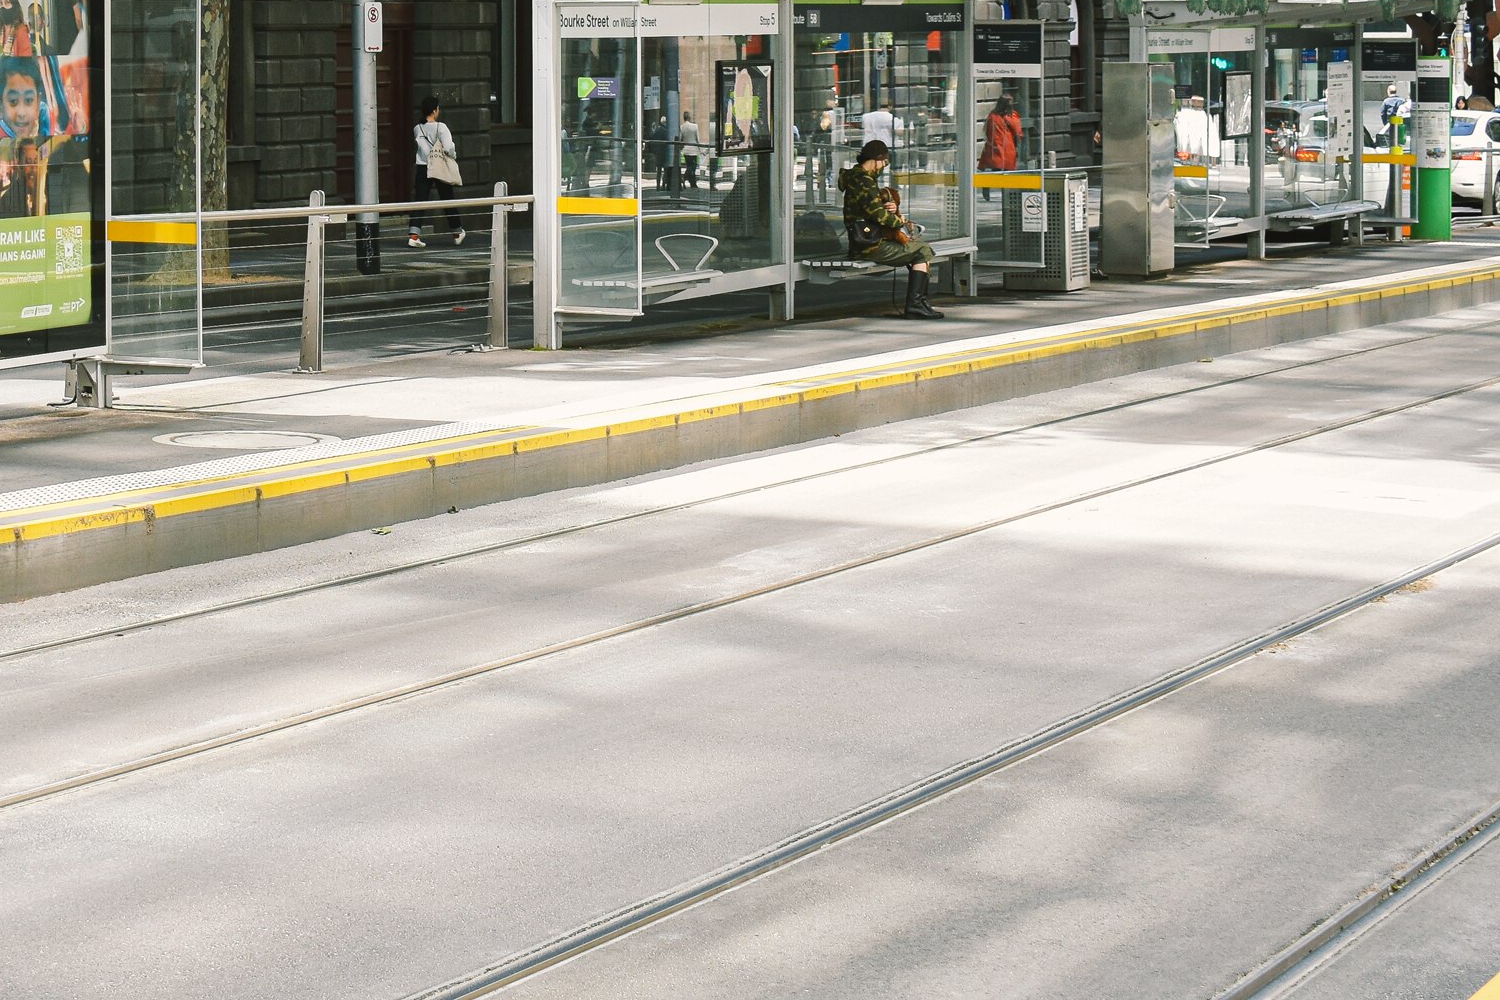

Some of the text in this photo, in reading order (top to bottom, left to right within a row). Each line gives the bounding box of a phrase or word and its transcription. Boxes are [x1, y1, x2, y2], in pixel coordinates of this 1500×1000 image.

[560, 14, 657, 28] Bourke Street on Willia Street
[759, 13, 775, 26] Stop 5
[25, 229, 45, 242] LIKE
[20, 249, 45, 260] AGAIN!
